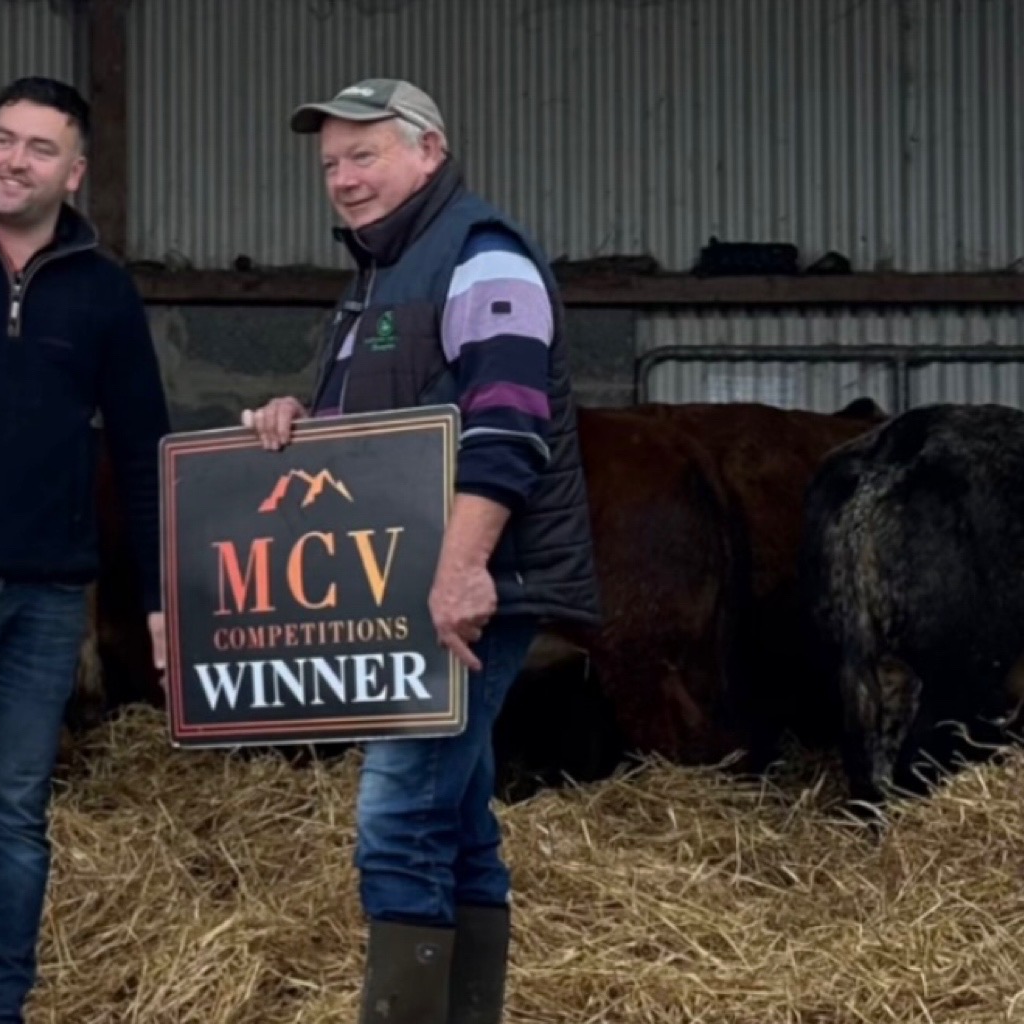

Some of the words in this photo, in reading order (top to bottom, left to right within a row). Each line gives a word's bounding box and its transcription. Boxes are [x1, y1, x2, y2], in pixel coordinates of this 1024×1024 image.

[212, 527, 404, 616] MCV
[213, 616, 408, 650] COMPETITIONS
[194, 651, 432, 711] WINNER
